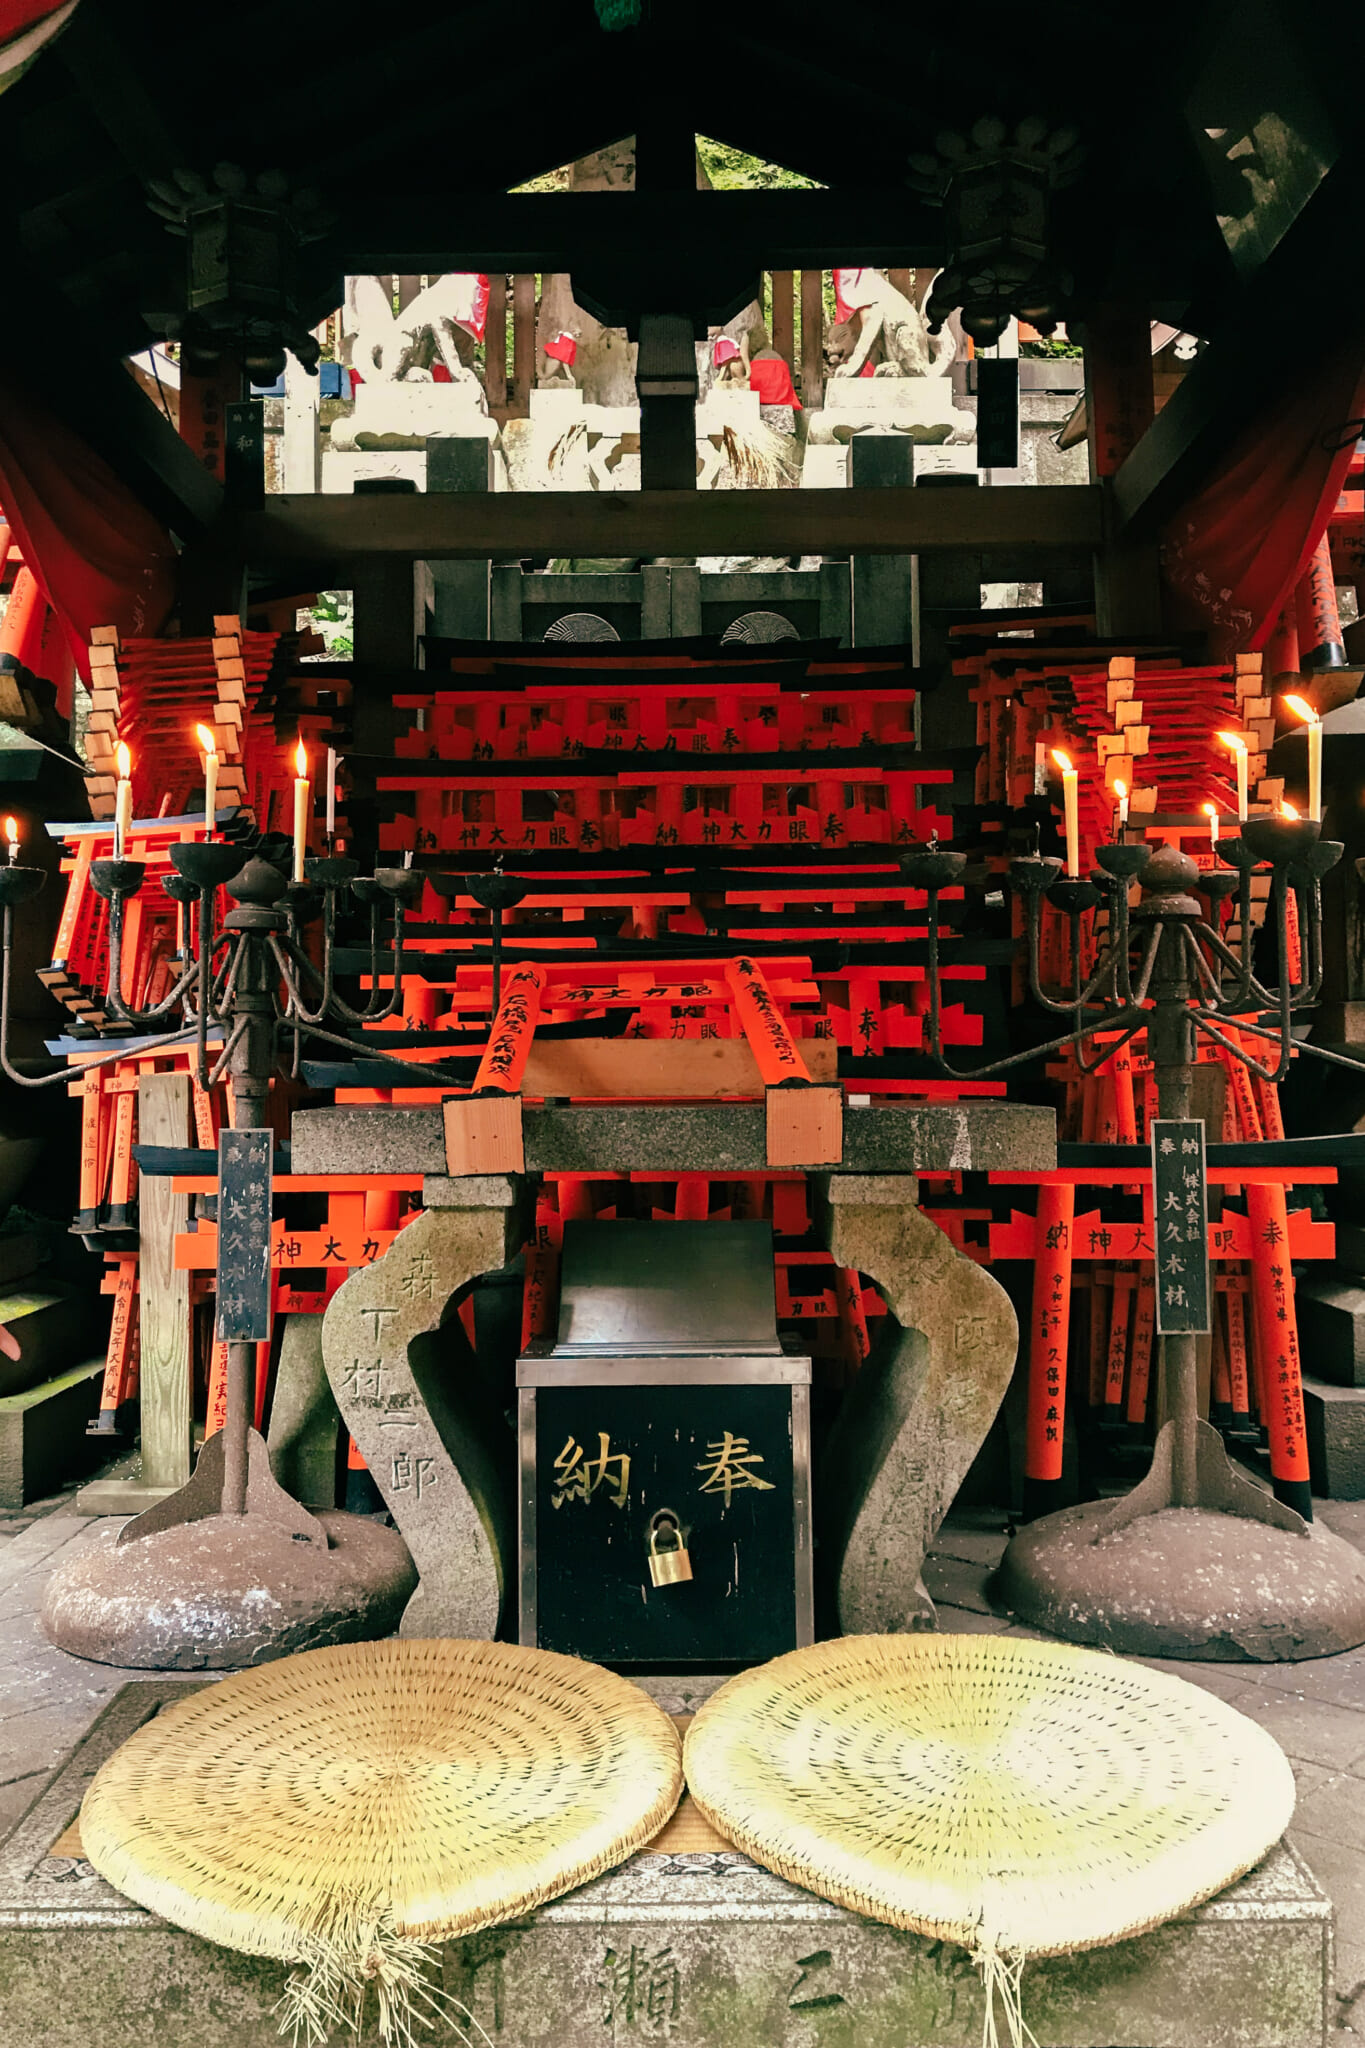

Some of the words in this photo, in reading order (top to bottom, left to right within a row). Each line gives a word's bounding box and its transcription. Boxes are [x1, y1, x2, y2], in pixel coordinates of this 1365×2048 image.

[580, 819, 601, 847] 奉
[656, 821, 679, 845] 納
[823, 812, 846, 843] 奉
[1160, 1137, 1199, 1155] 奉納
[248, 1182, 265, 1249] 株式会社
[1184, 1173, 1201, 1242] 株式会社
[1045, 1221, 1069, 1250] 納
[1163, 1191, 1187, 1307] 大久木材
[1261, 1218, 1284, 1250] 奉
[225, 1199, 249, 1315] 大久木材
